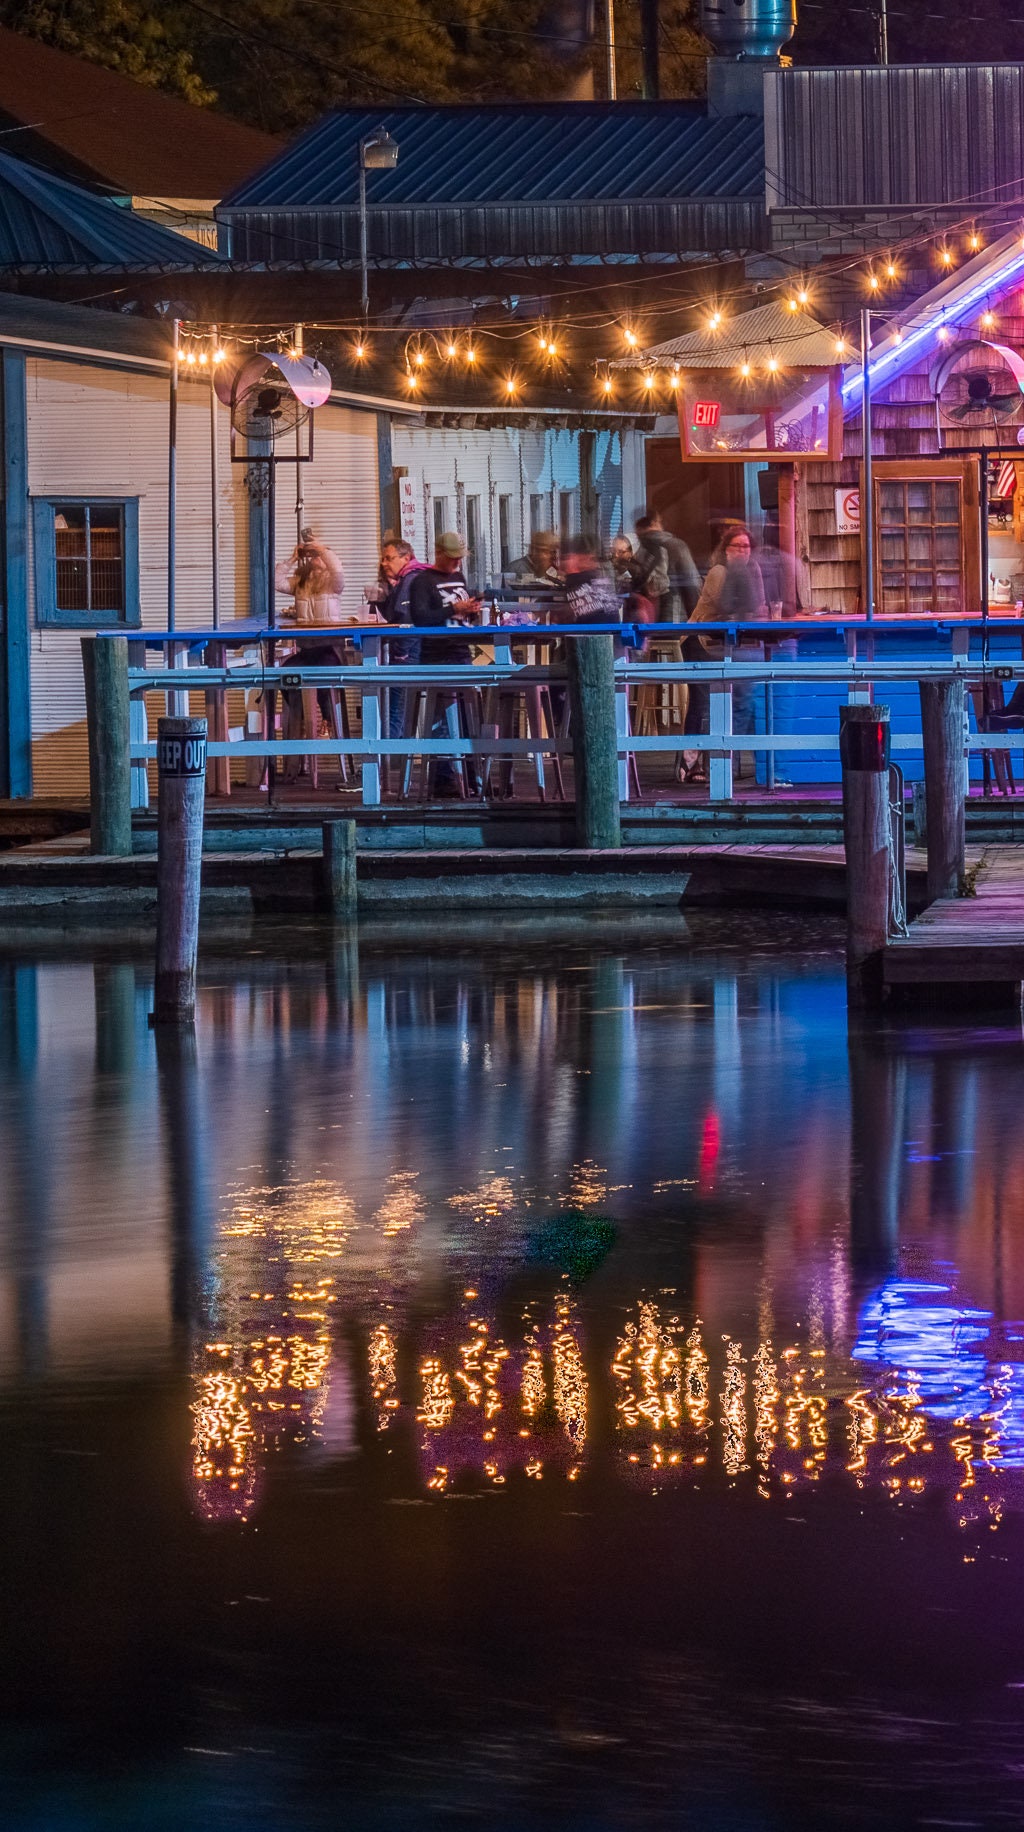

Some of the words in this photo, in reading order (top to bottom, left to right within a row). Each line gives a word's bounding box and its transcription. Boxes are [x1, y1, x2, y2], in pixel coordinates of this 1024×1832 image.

[696, 404, 718, 425] EXIT
[160, 741, 182, 769] EEP
[185, 740, 206, 769] OUT
